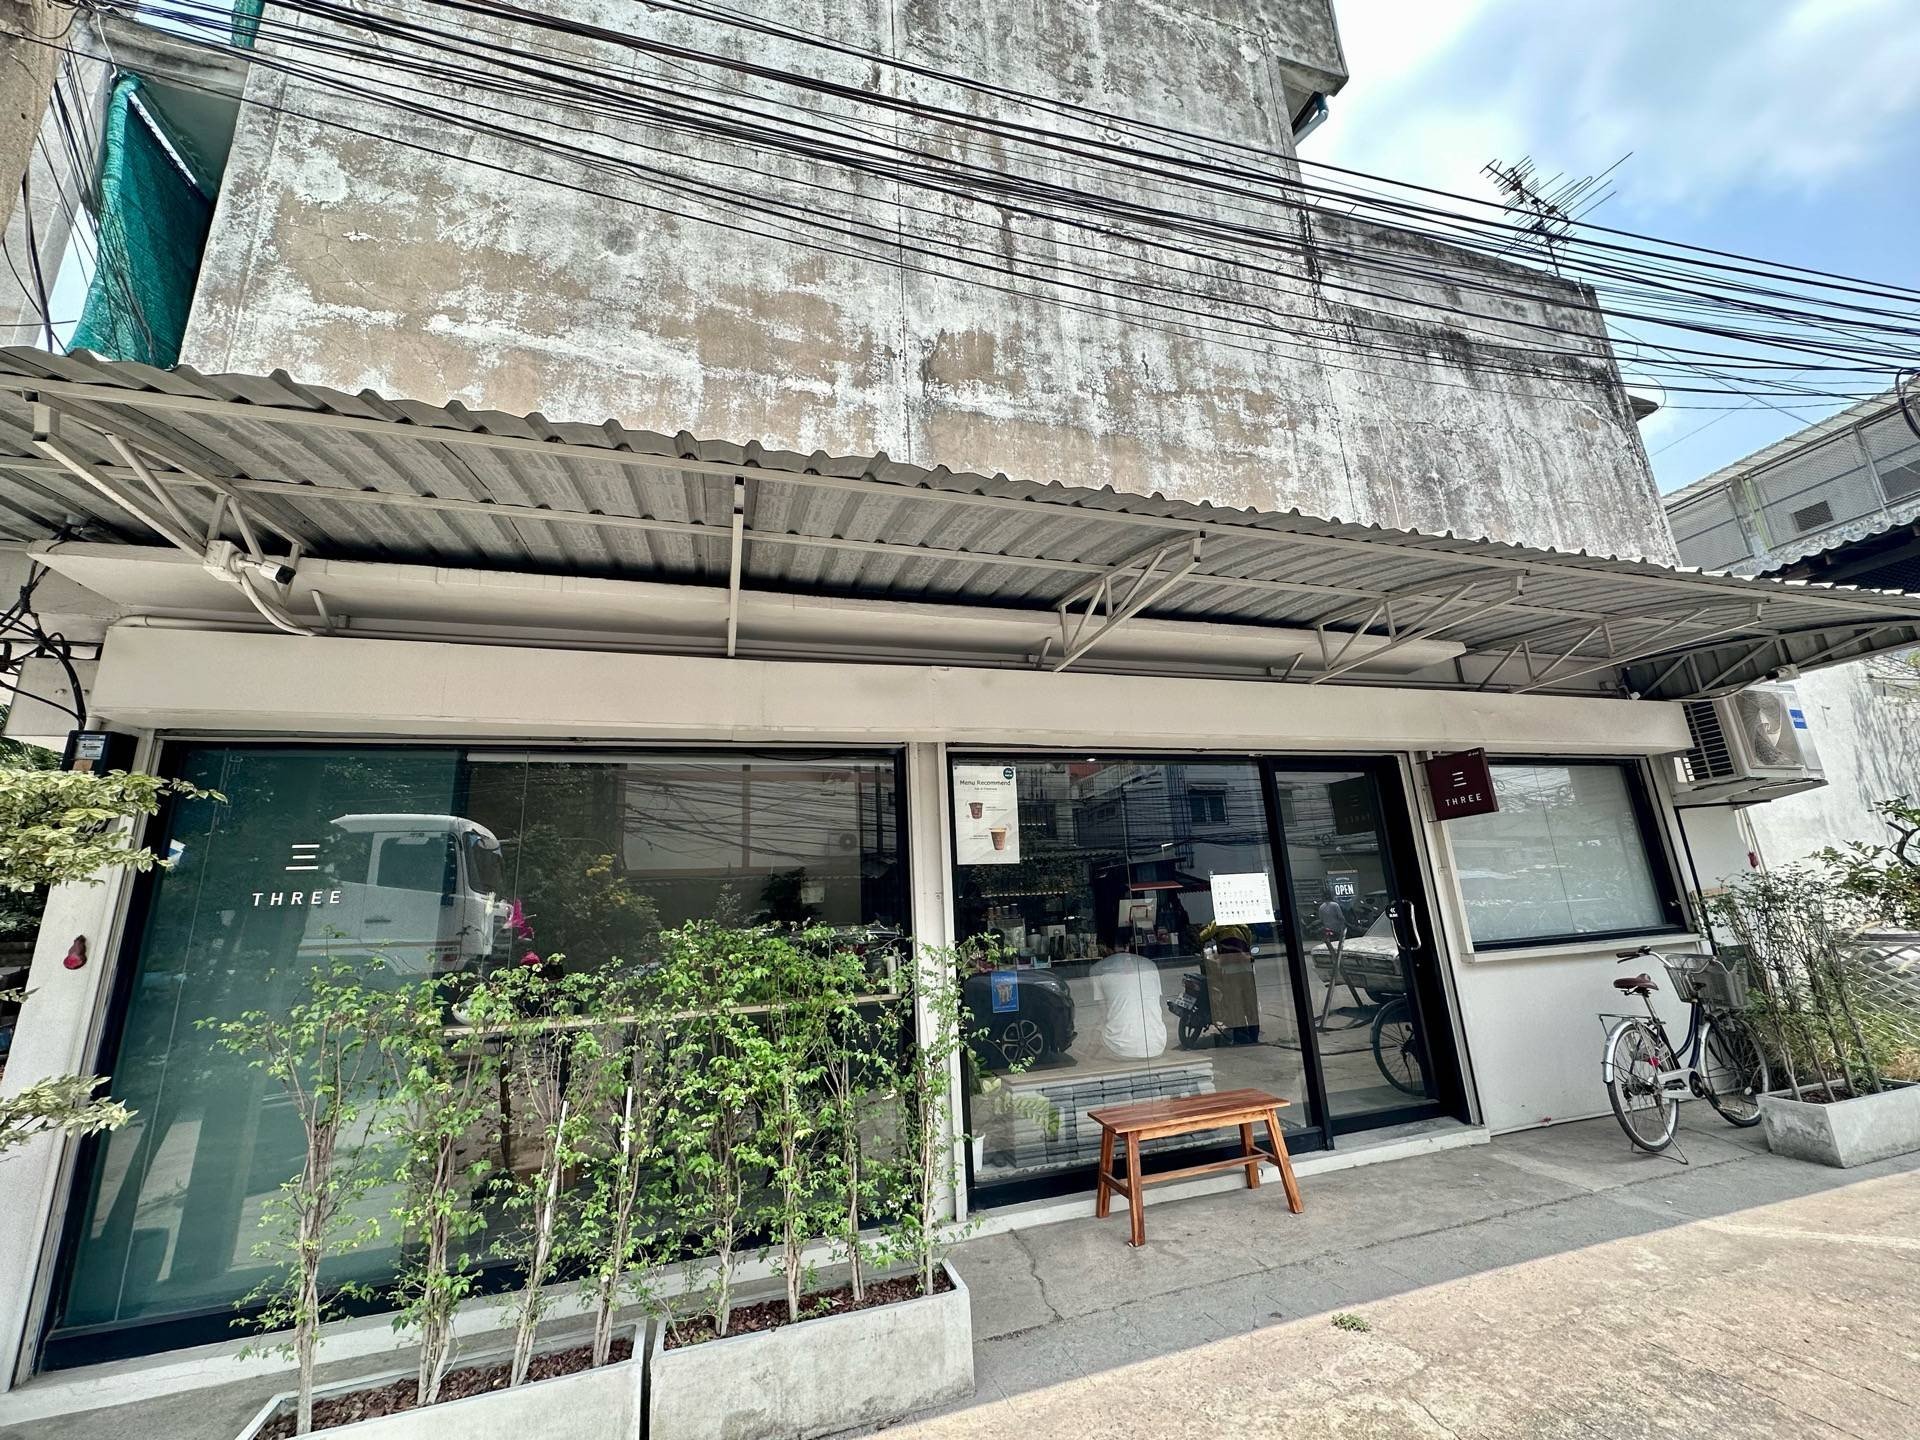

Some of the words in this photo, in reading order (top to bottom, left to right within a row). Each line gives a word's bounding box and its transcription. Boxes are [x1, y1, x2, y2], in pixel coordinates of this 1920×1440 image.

[1445, 793, 1482, 807] THREE
[1334, 883, 1355, 896] OPEN
[252, 890, 341, 907] THREE
